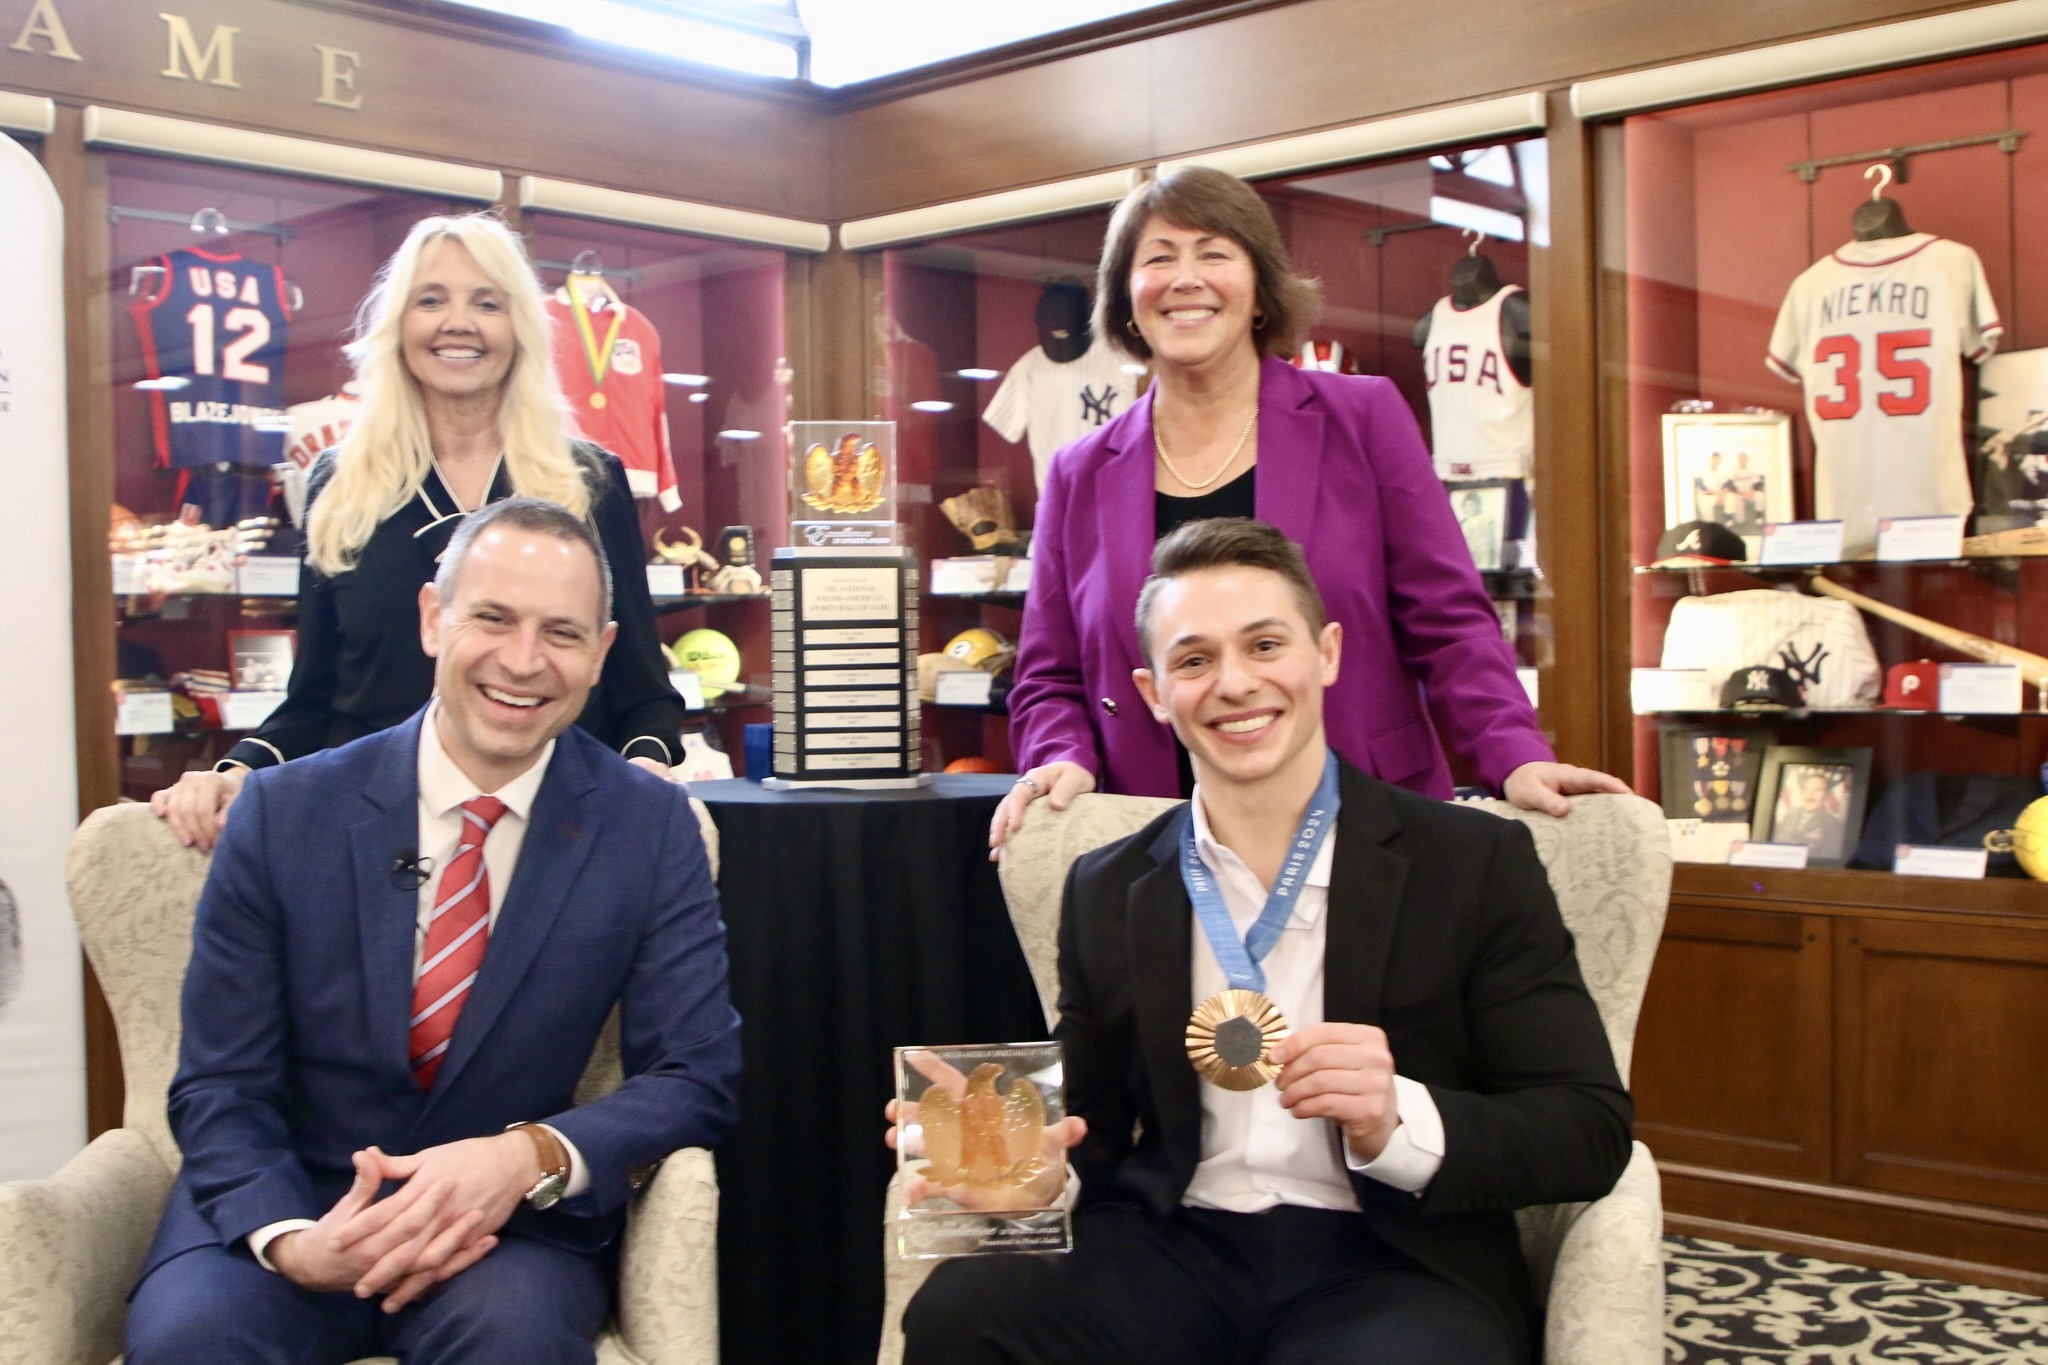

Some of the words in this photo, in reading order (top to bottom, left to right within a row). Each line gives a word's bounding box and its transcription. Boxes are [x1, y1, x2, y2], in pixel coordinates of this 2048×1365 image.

[187, 265, 260, 307] USA
[1820, 280, 1930, 328] NIEKRO
[185, 302, 271, 386] 12
[1423, 344, 1504, 397] USA
[1813, 327, 1933, 421] 35
[1276, 852, 1306, 896] PARIS
[1296, 809, 1326, 849] 2024
